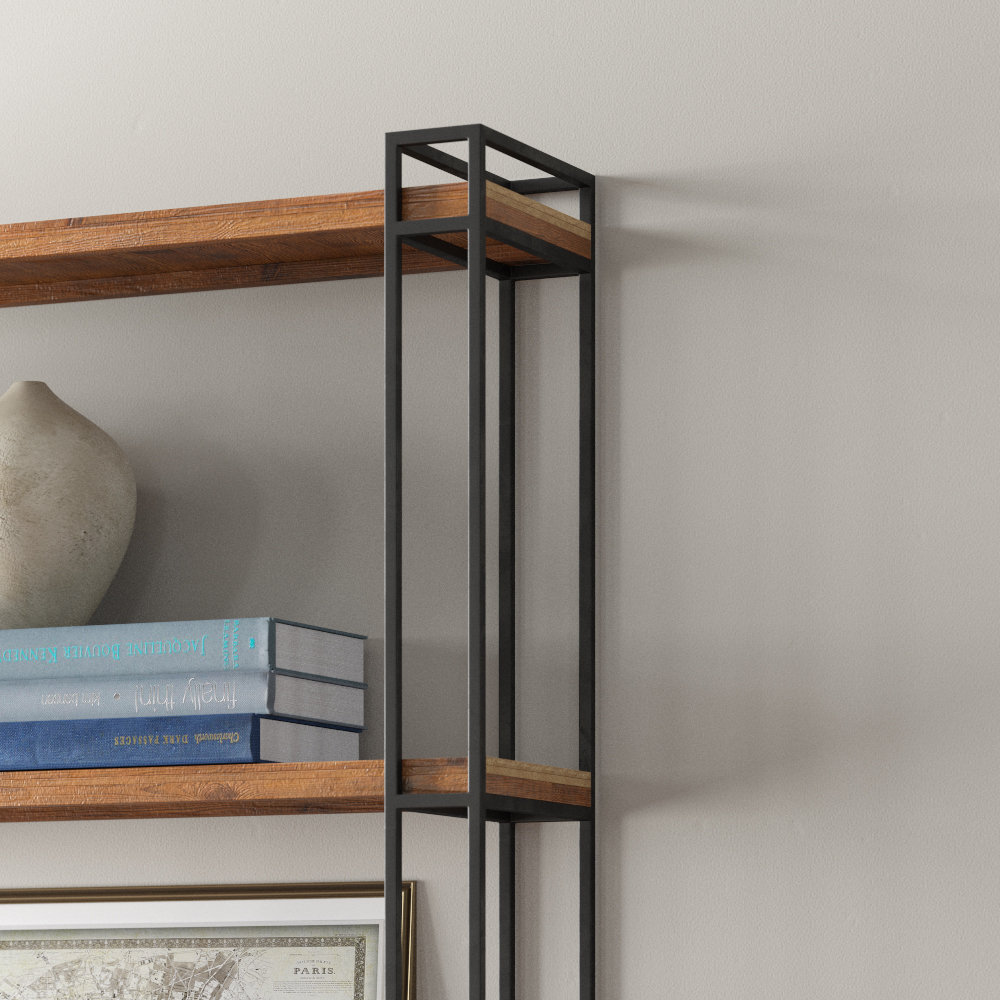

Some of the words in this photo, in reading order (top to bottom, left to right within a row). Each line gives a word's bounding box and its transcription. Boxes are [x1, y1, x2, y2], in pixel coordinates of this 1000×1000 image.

[63, 643, 121, 661] BOUVIER
[181, 677, 238, 711] finally
[113, 734, 160, 747] PASSAGES
[161, 734, 189, 745] DARK
